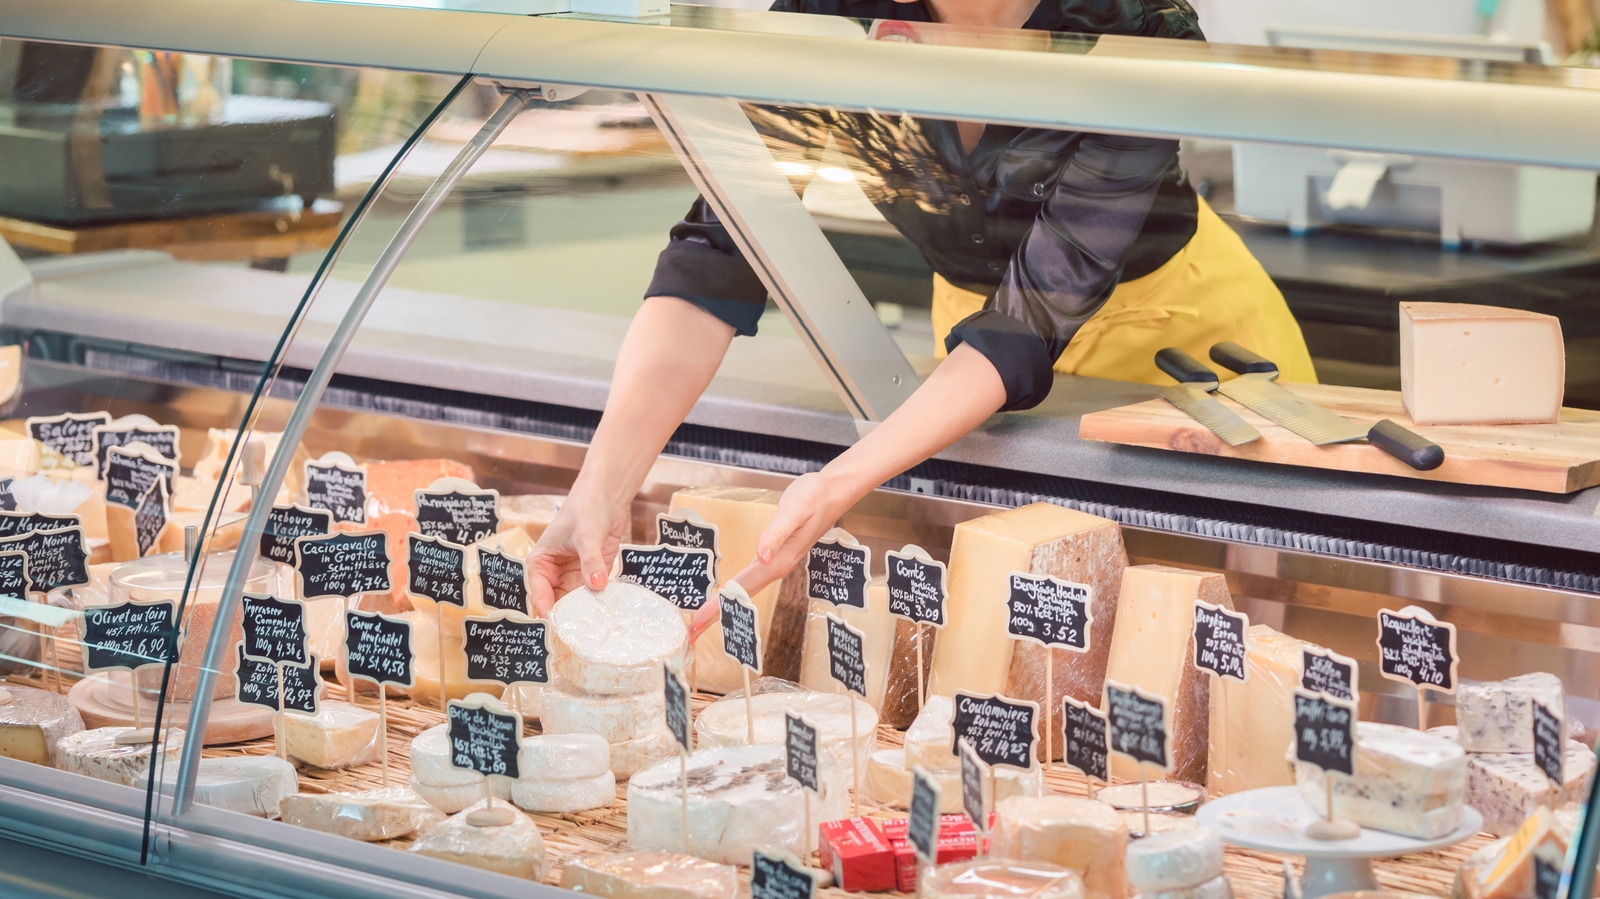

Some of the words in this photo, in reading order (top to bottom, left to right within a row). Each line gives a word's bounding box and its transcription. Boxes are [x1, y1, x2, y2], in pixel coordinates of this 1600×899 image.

[269, 510, 312, 528] riebourg
[662, 521, 704, 545] Beaufort
[28, 541, 40, 551] de
[270, 546, 293, 562] 100g
[302, 537, 377, 555] Caciocavallo
[415, 541, 459, 564] Caciocavallo
[321, 554, 330, 563] in
[334, 550, 377, 563] Grotta
[327, 560, 386, 572] Schnittkäse
[641, 565, 708, 577] Normandie
[897, 560, 926, 581] Comté
[330, 572, 347, 580] Fett
[324, 581, 345, 593] 100g
[812, 583, 829, 599] 100g
[891, 599, 910, 616] 100g
[92, 609, 131, 625] Olivet
[130, 612, 144, 622] au
[125, 624, 142, 636] Fett
[495, 624, 545, 639] Camembert
[1011, 616, 1034, 633] 100g
[1042, 623, 1077, 643] 3,52
[1213, 626, 1238, 642] Extra
[1382, 614, 1432, 638] Roquefort
[138, 637, 164, 657] 6,90
[255, 638, 272, 657] 100g
[491, 635, 537, 645] Weichkäse
[368, 656, 380, 672] St.
[471, 654, 488, 669] 100g
[490, 654, 511, 667] 3,32
[1201, 649, 1218, 669] 100g
[255, 662, 299, 677] Rohlch
[495, 666, 510, 679] St.
[1394, 664, 1412, 679] 100g
[1419, 667, 1443, 684] 4,10
[243, 683, 261, 701] 400g
[450, 706, 471, 721] Brie
[473, 711, 486, 725] de
[960, 697, 1029, 723] Coulommiers
[973, 714, 1016, 731] Rohmilch
[980, 737, 993, 753] St.
[995, 739, 1028, 759] 14,25
[455, 753, 473, 769] 100g
[480, 760, 506, 775] 2,69
